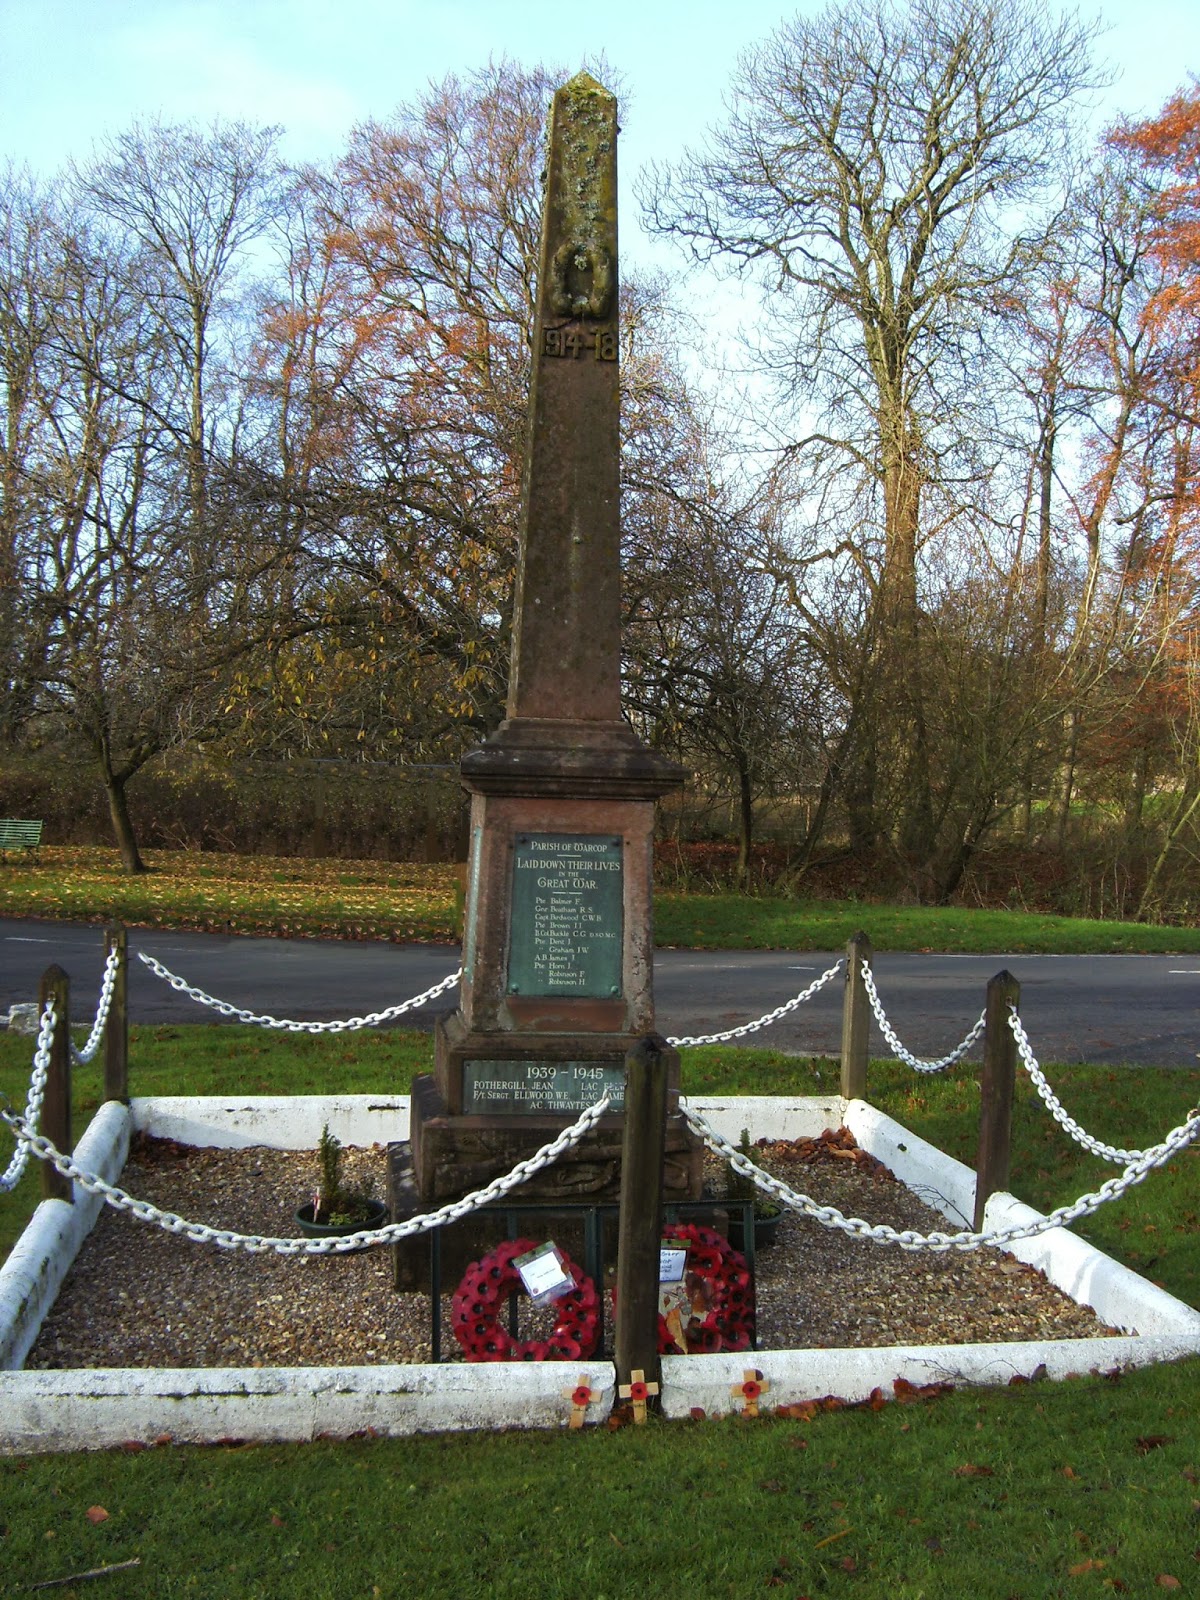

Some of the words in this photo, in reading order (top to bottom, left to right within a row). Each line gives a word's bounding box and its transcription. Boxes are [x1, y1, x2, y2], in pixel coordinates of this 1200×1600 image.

[574, 843, 607, 852] WARCOP
[517, 858, 538, 868] LAID
[540, 860, 565, 869] DOWN
[568, 861, 592, 870] THEIR
[595, 862, 620, 870] LIVES
[537, 877, 569, 888] GREAT
[527, 1067, 556, 1079] 1939
[573, 1068, 603, 1079] 1945
